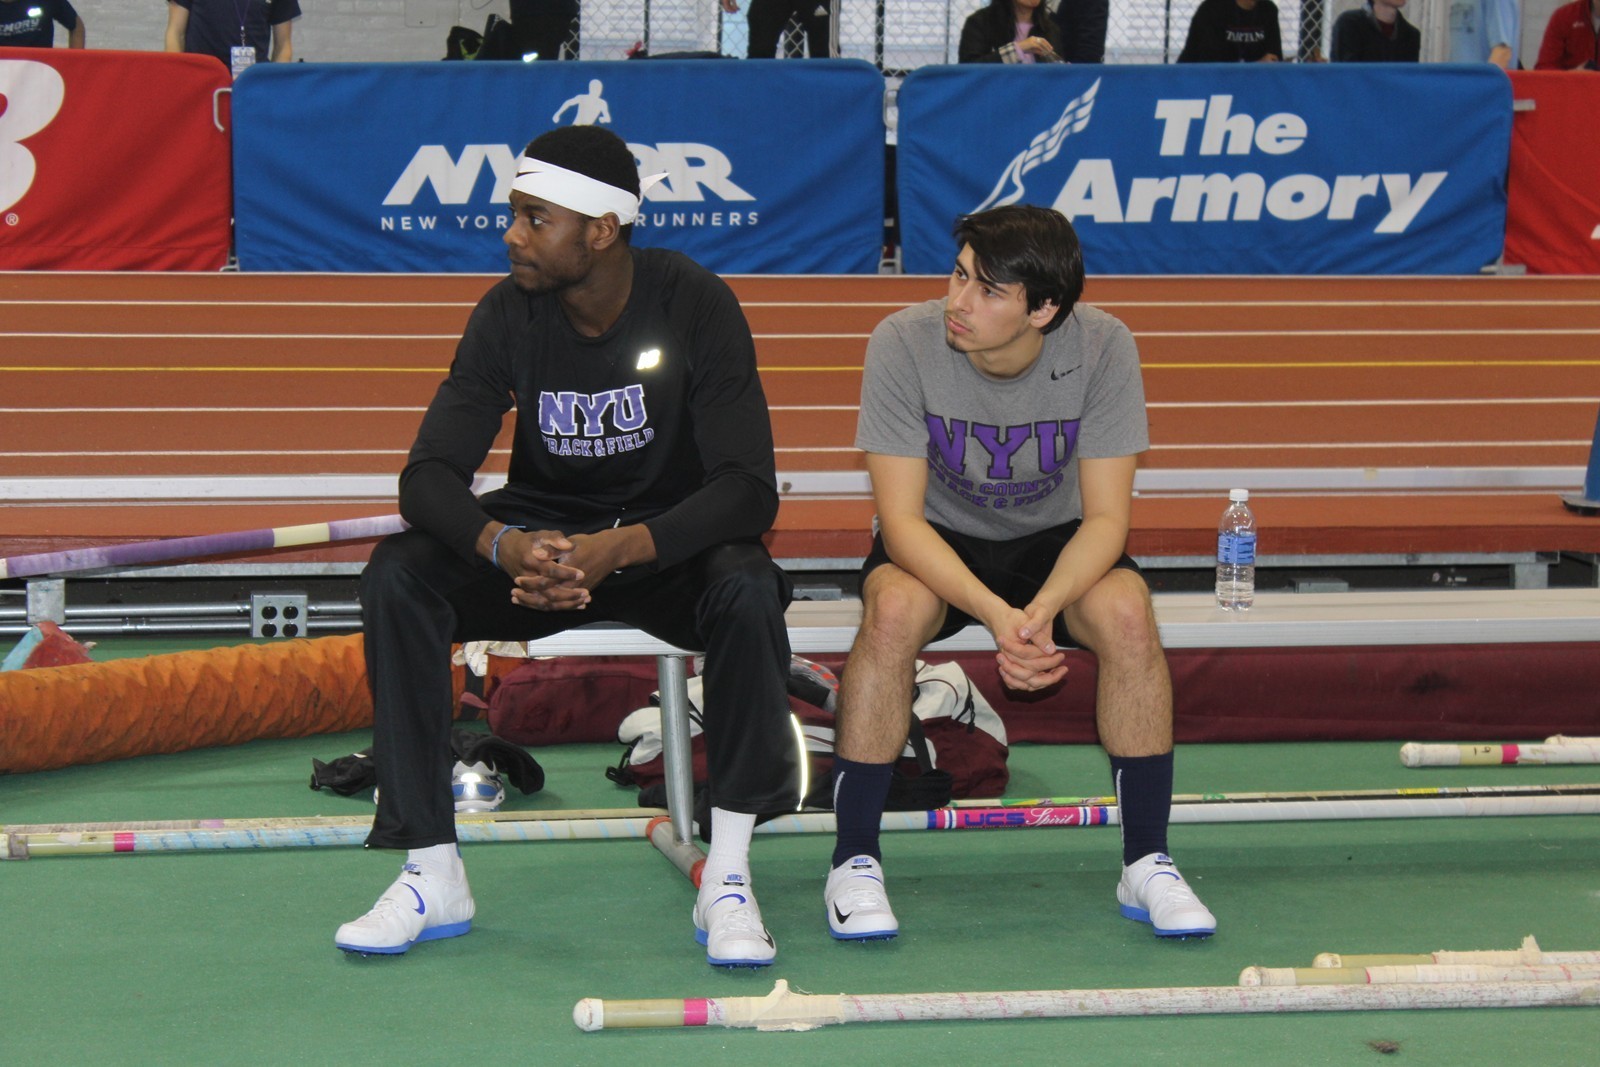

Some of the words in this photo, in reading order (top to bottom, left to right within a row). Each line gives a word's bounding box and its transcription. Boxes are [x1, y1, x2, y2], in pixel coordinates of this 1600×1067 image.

[1154, 94, 1308, 156] The
[380, 215, 437, 231] NEW
[456, 214, 508, 230] YOR
[634, 211, 760, 227] RUNNERS
[1051, 158, 1449, 234] Armory
[538, 383, 648, 437] NYU
[924, 411, 1081, 480] NYU
[965, 812, 1025, 826] UCS
[1025, 807, 1076, 827] Spirit
